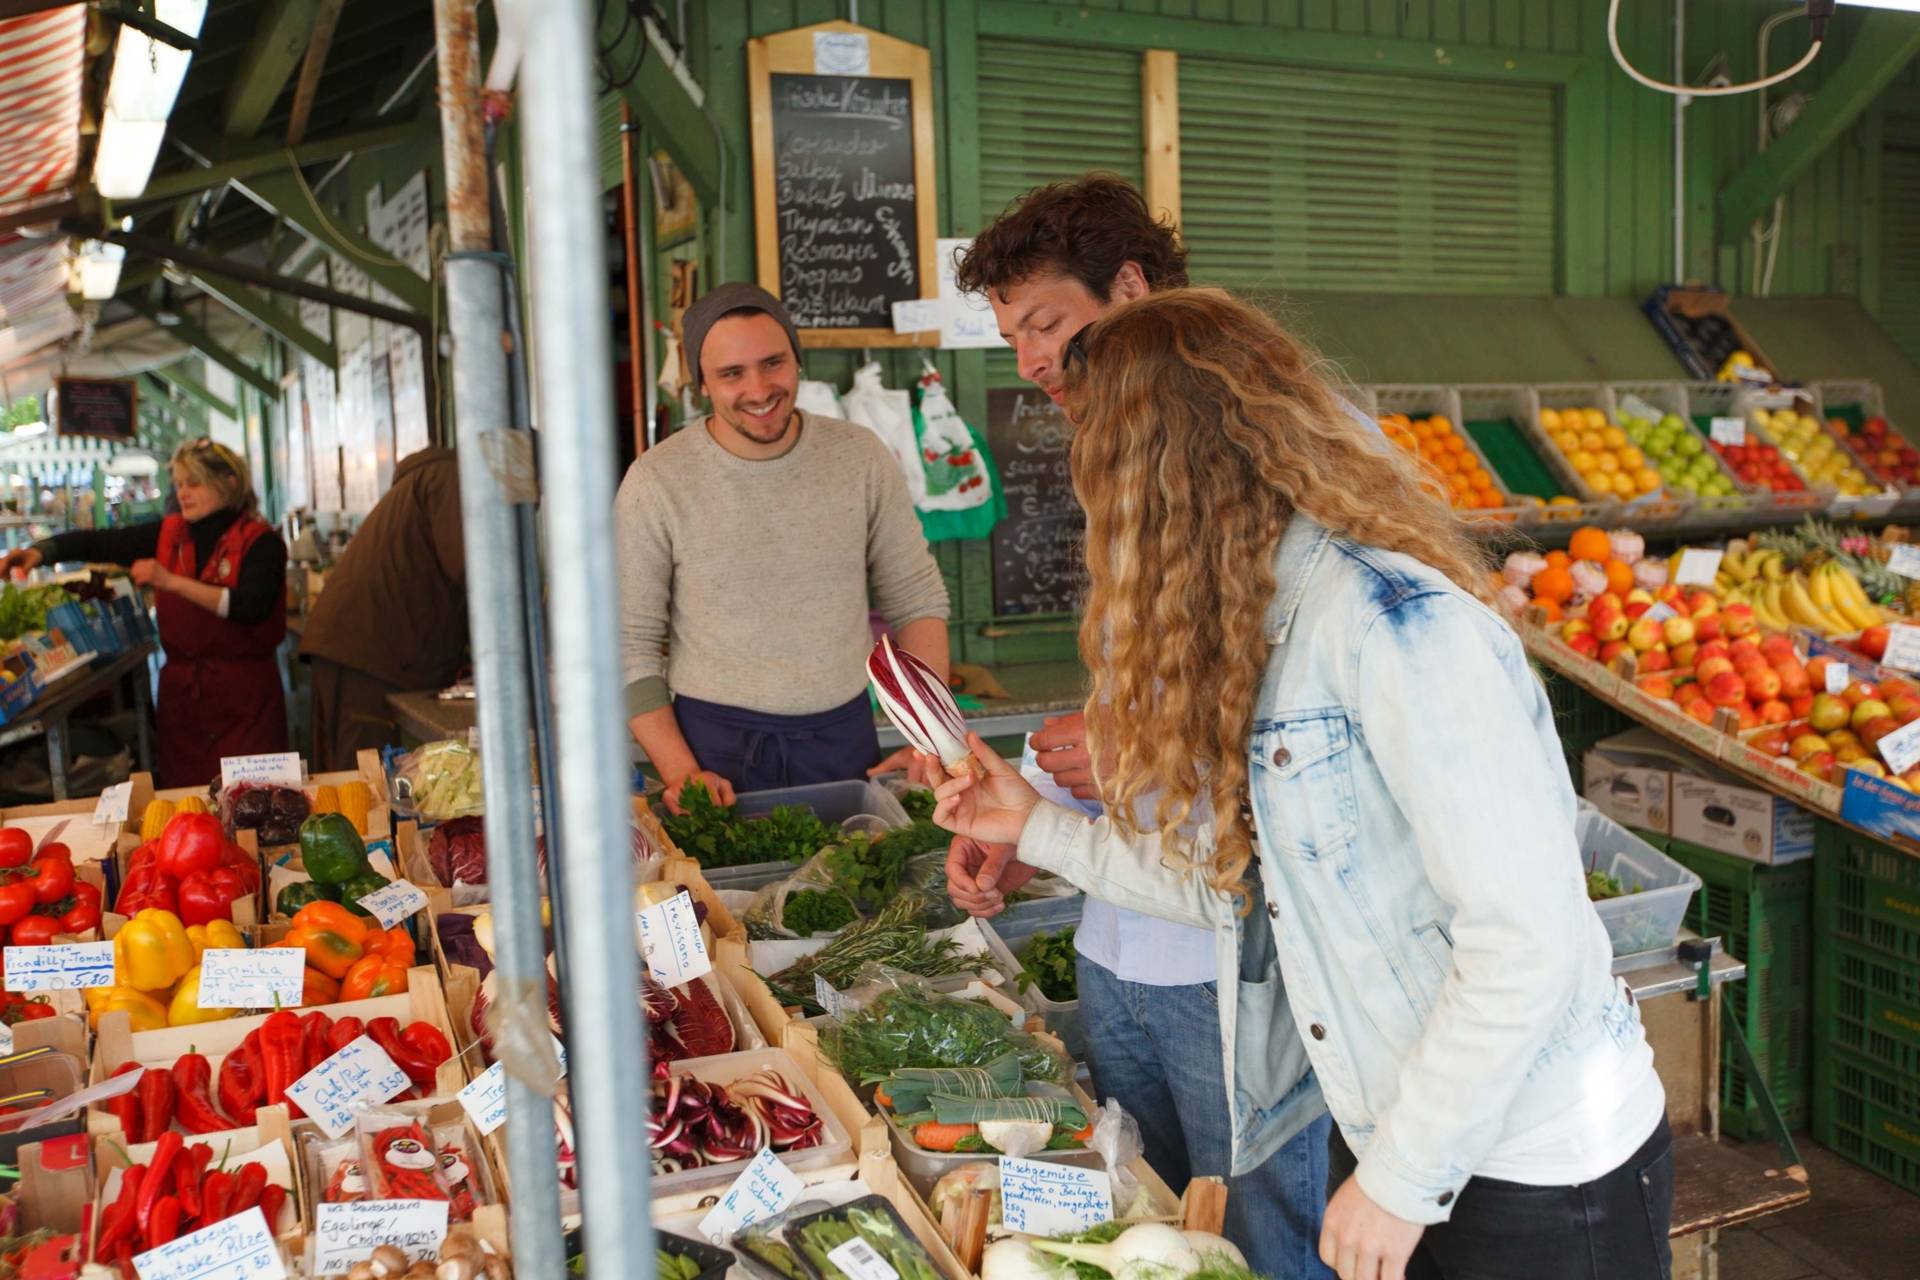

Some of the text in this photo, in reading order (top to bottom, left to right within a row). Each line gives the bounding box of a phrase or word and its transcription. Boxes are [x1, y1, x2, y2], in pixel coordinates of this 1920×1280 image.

[779, 209, 874, 247] Thymian
[781, 233, 879, 262] Rosmarin
[205, 959, 282, 980] Paprika
[1003, 1159, 1086, 1185] Mischgemüse
[1060, 1183, 1101, 1203] Beilage
